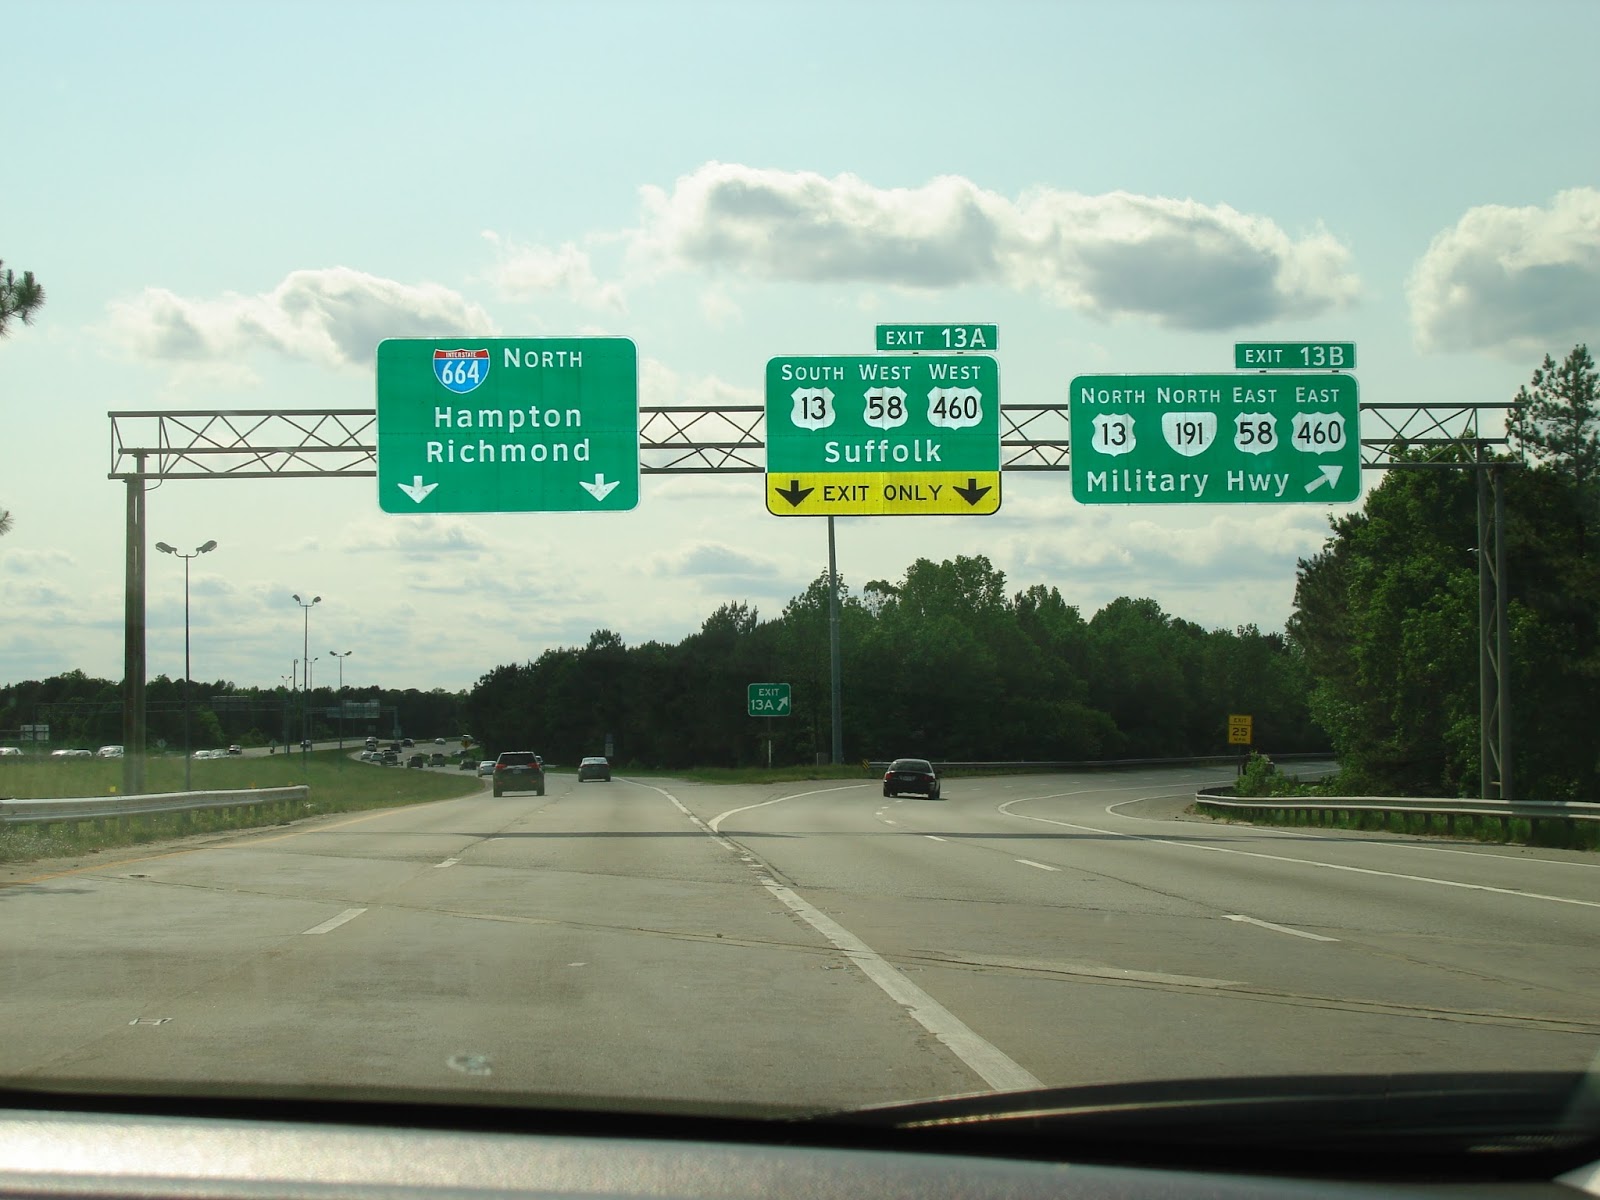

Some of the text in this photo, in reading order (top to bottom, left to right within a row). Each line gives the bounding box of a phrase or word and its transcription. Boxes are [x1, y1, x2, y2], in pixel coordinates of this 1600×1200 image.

[886, 328, 987, 348] EXIT 13A
[503, 348, 583, 368] NORTH
[1245, 346, 1344, 366] EXIT 13B
[442, 360, 480, 385] 664
[781, 363, 981, 380] SOUTH WEST WEST
[1081, 387, 1340, 404] NORTH NORTH EAST EAST
[801, 395, 978, 420] 13 58 460
[434, 405, 582, 433] Hampton
[1101, 420, 1341, 446] 13 191 58 460
[426, 438, 590, 463] Richmond
[824, 439, 942, 463] Suffolk
[823, 484, 943, 502] EXIT ONLY
[1086, 469, 1289, 498] Military Hwy
[758, 688, 780, 697] EXIT
[750, 699, 774, 710] 13A
[1232, 727, 1248, 737] 25
